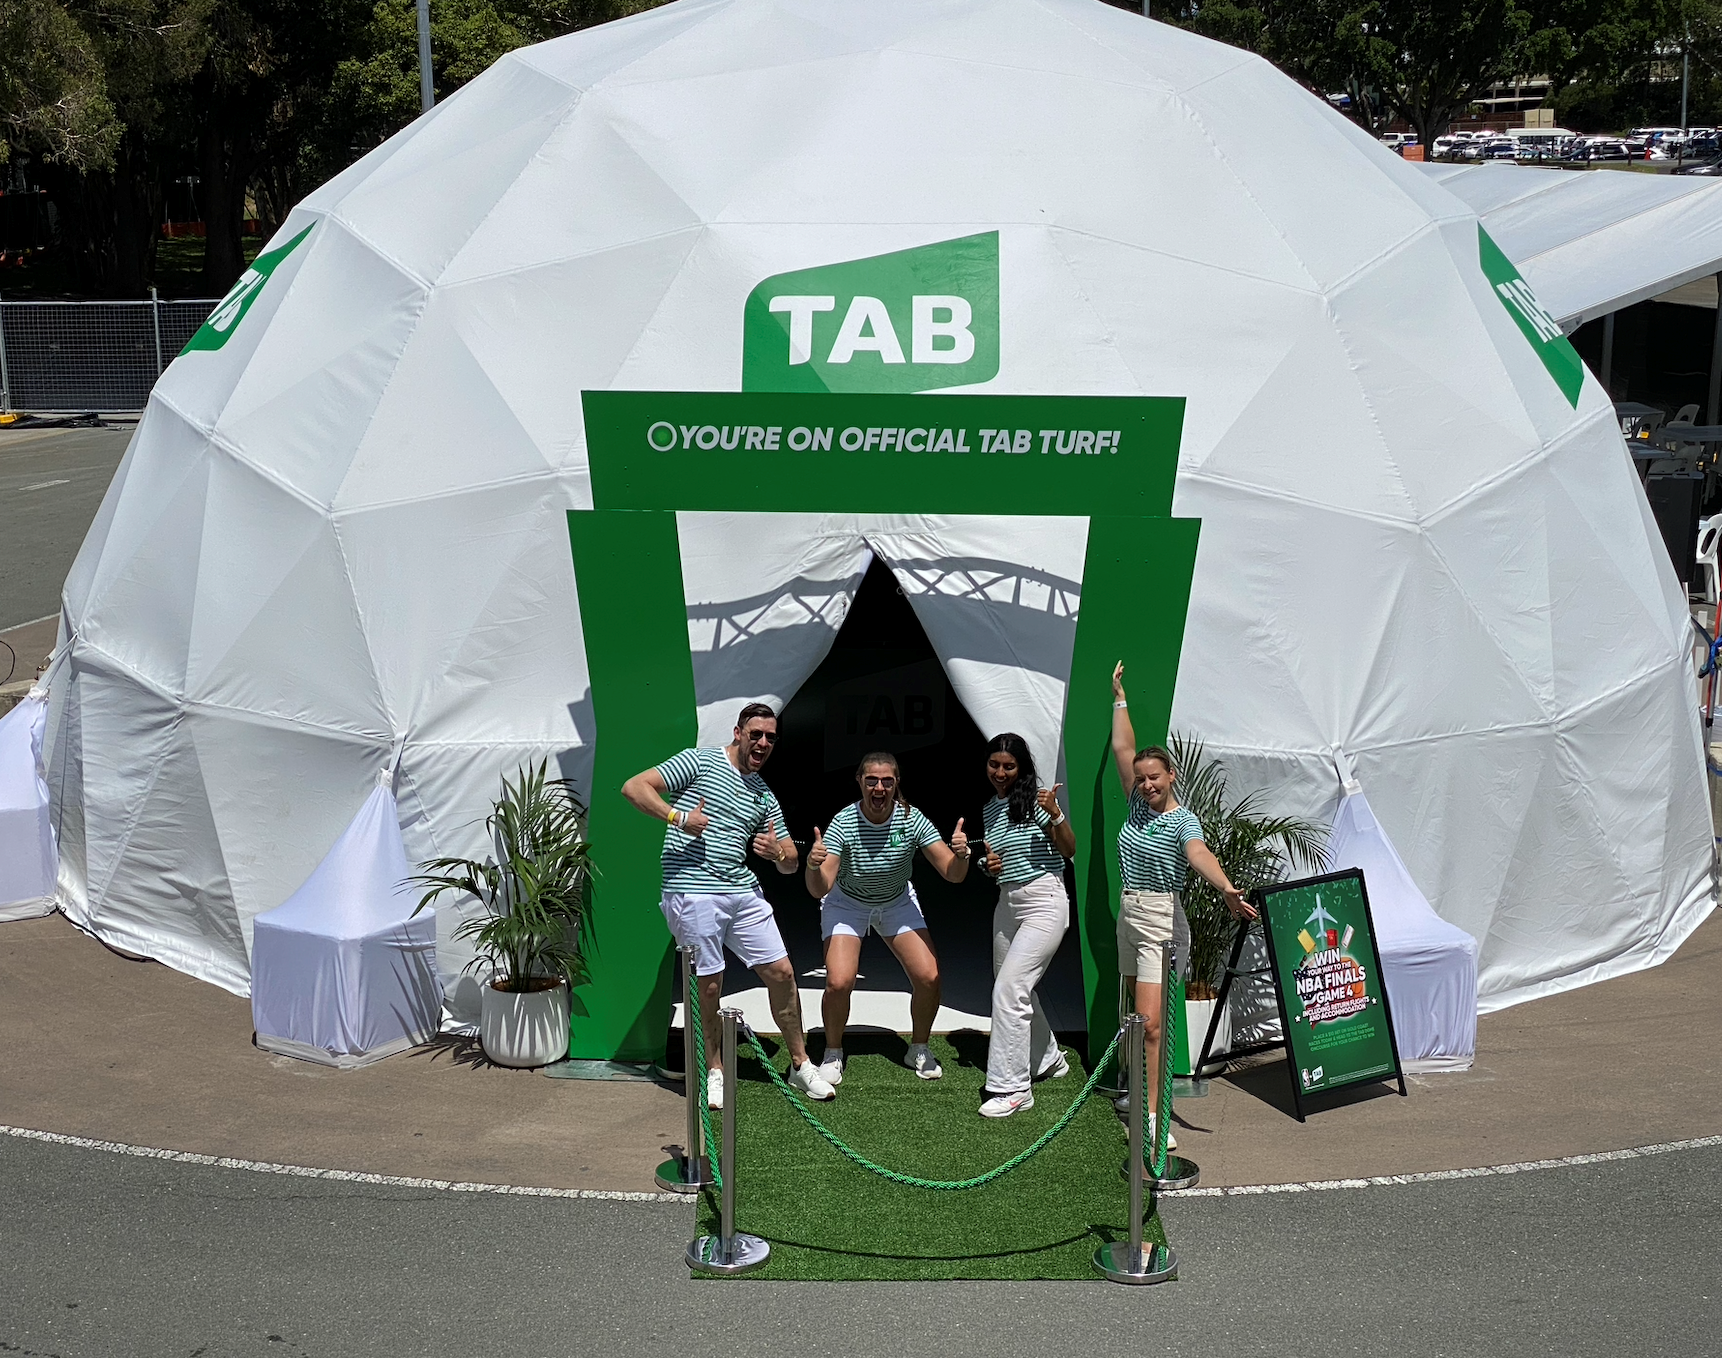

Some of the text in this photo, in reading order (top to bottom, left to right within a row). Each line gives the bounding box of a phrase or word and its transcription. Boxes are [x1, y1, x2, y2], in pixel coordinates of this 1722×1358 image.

[1496, 278, 1564, 344] TAB
[769, 296, 974, 366] TAB
[680, 426, 1121, 454] YOU'RE ON OFFICIAL TAB TURF!
[838, 694, 934, 736] TAB
[1308, 961, 1351, 976] YOUR WAY TO THE
[1315, 948, 1340, 967] WIN
[1297, 966, 1366, 995] NBA FINALS
[1303, 996, 1369, 1017] INCLUDING RETURN FLIGHTS
[1317, 985, 1353, 1004] GAME 4
[1309, 1003, 1366, 1022] AND ACCOMMODATION
